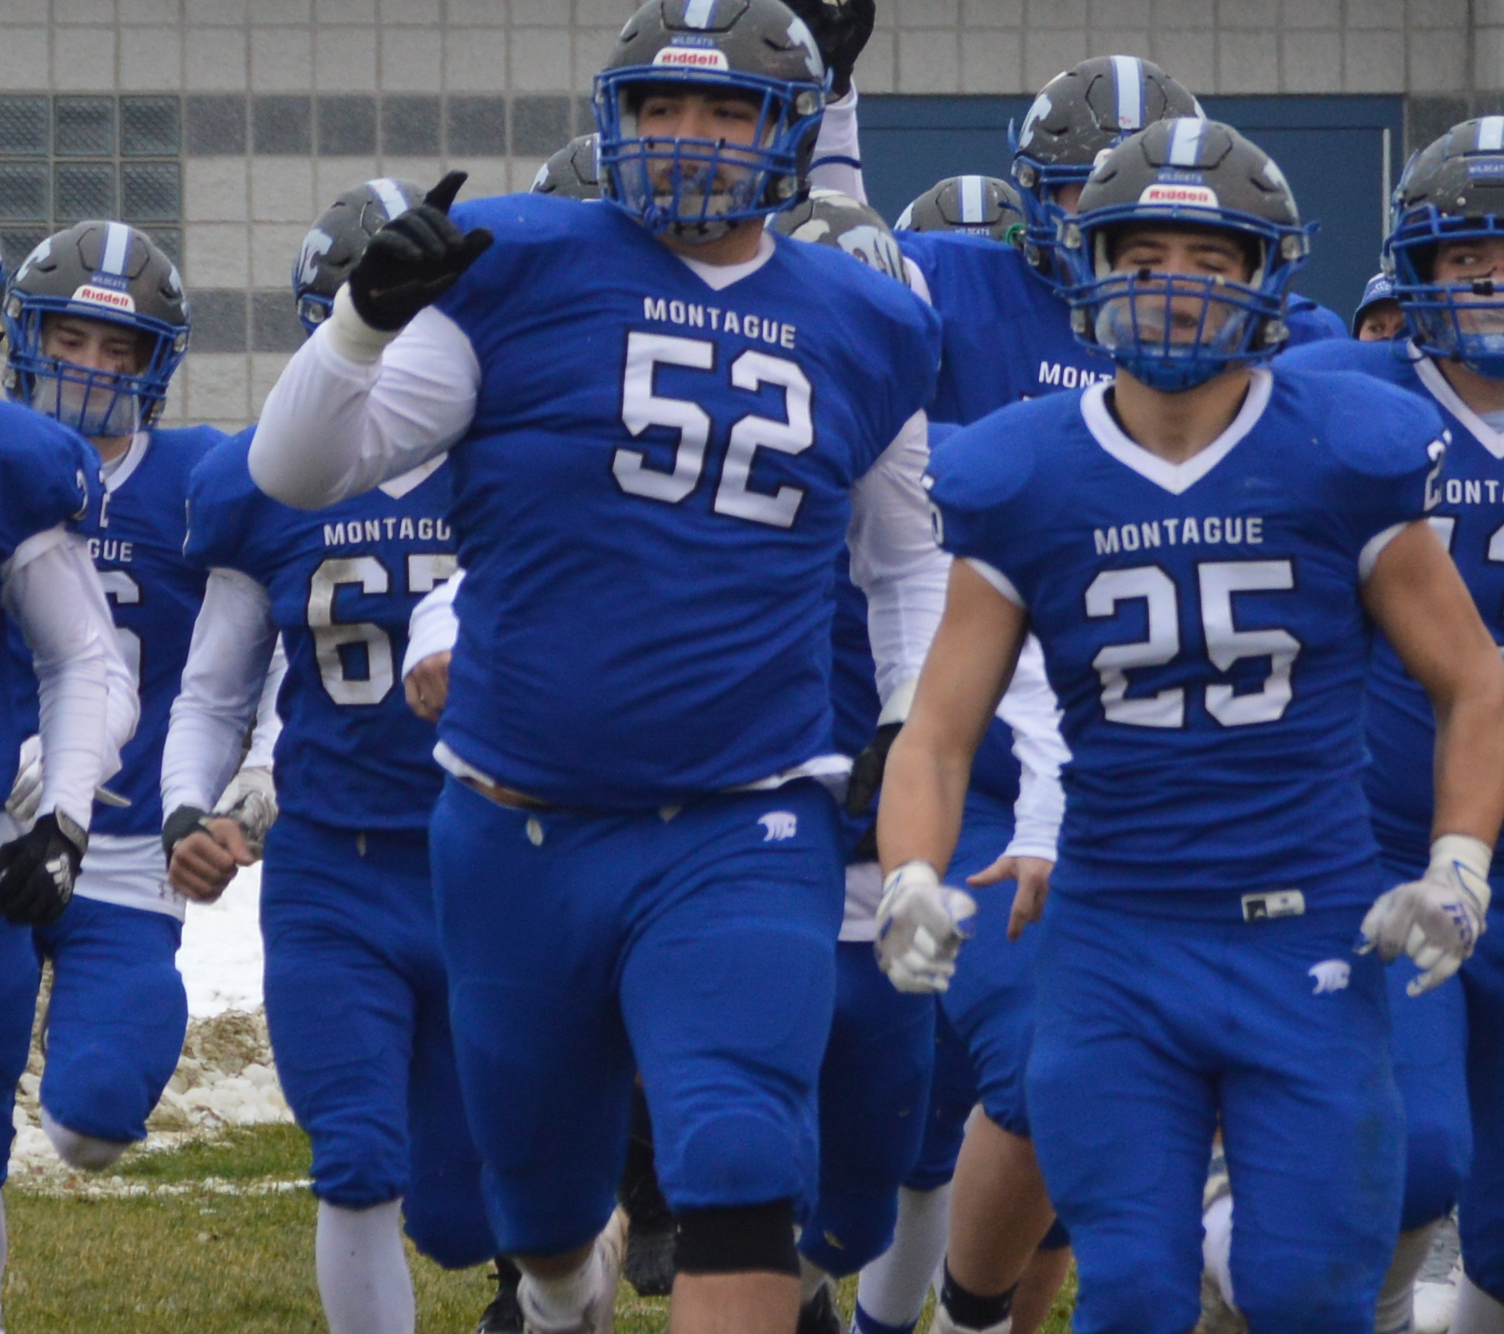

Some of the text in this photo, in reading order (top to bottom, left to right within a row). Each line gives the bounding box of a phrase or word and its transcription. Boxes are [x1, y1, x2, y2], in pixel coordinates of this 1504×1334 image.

[662, 53, 718, 66] Riddell
[81, 287, 129, 307] Riddell
[643, 297, 796, 349] MONTAGUE
[611, 331, 813, 529] 52
[1093, 516, 1264, 555] MONTAGUE
[1084, 560, 1300, 729] 25
